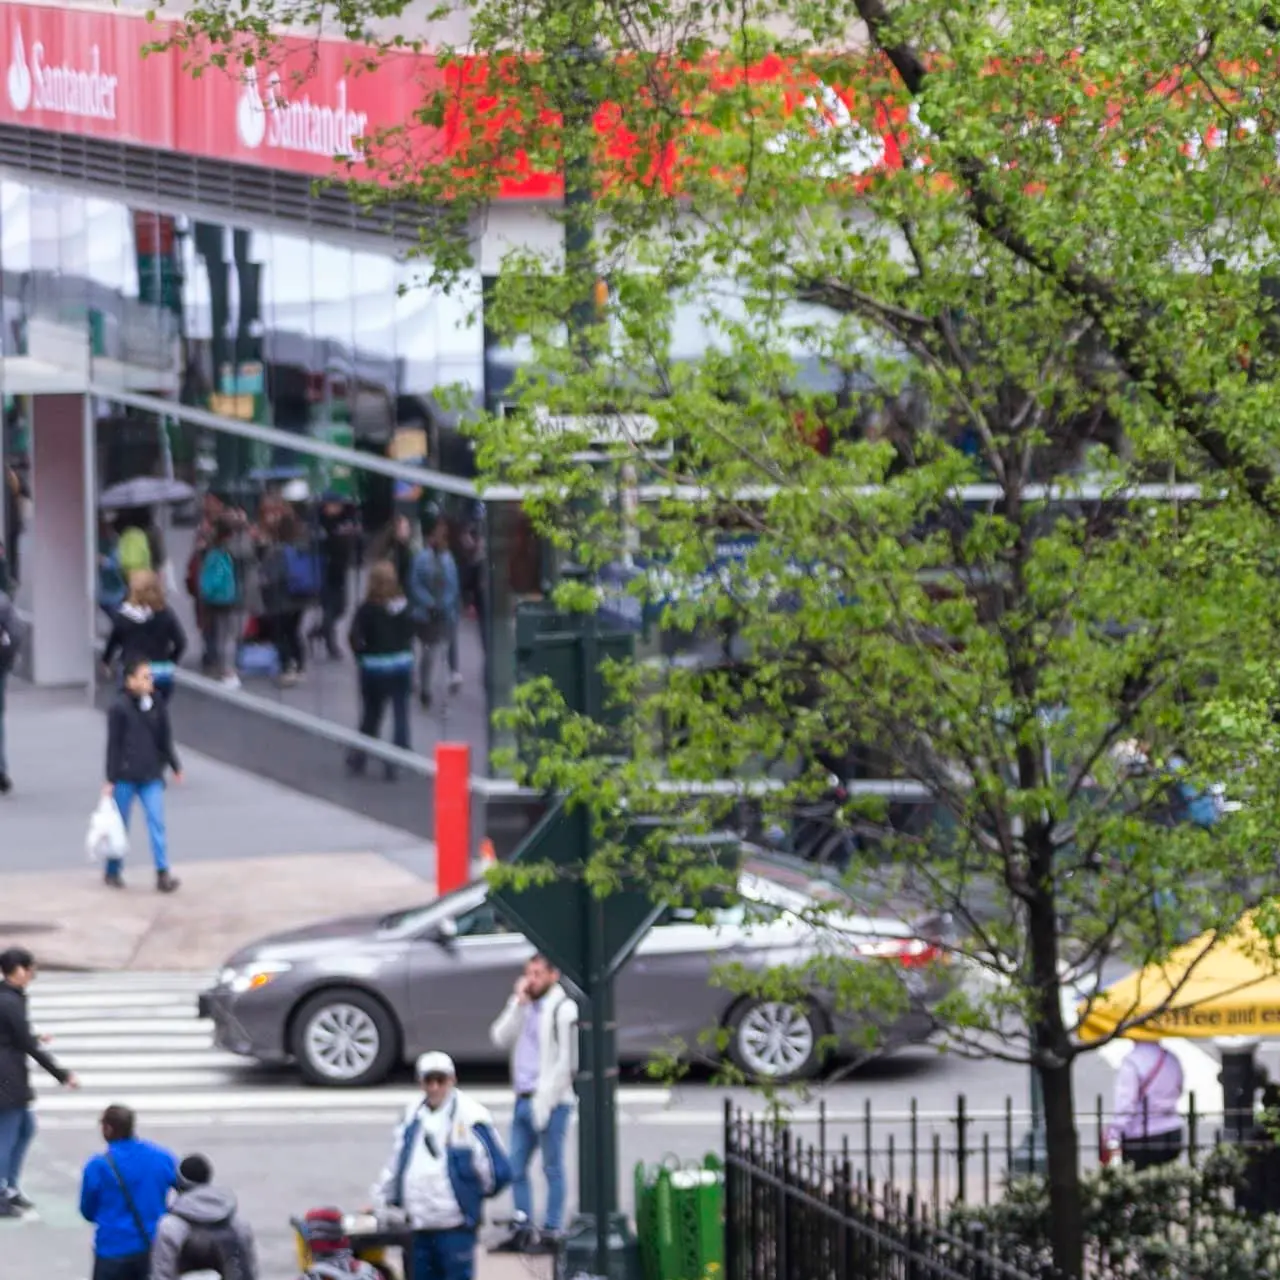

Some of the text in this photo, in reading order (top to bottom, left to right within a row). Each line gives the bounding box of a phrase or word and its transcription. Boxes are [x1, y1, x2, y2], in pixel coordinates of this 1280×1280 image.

[32, 39, 118, 121] Santander
[266, 70, 368, 163] Santander
[1228, 1004, 1256, 1025] and
